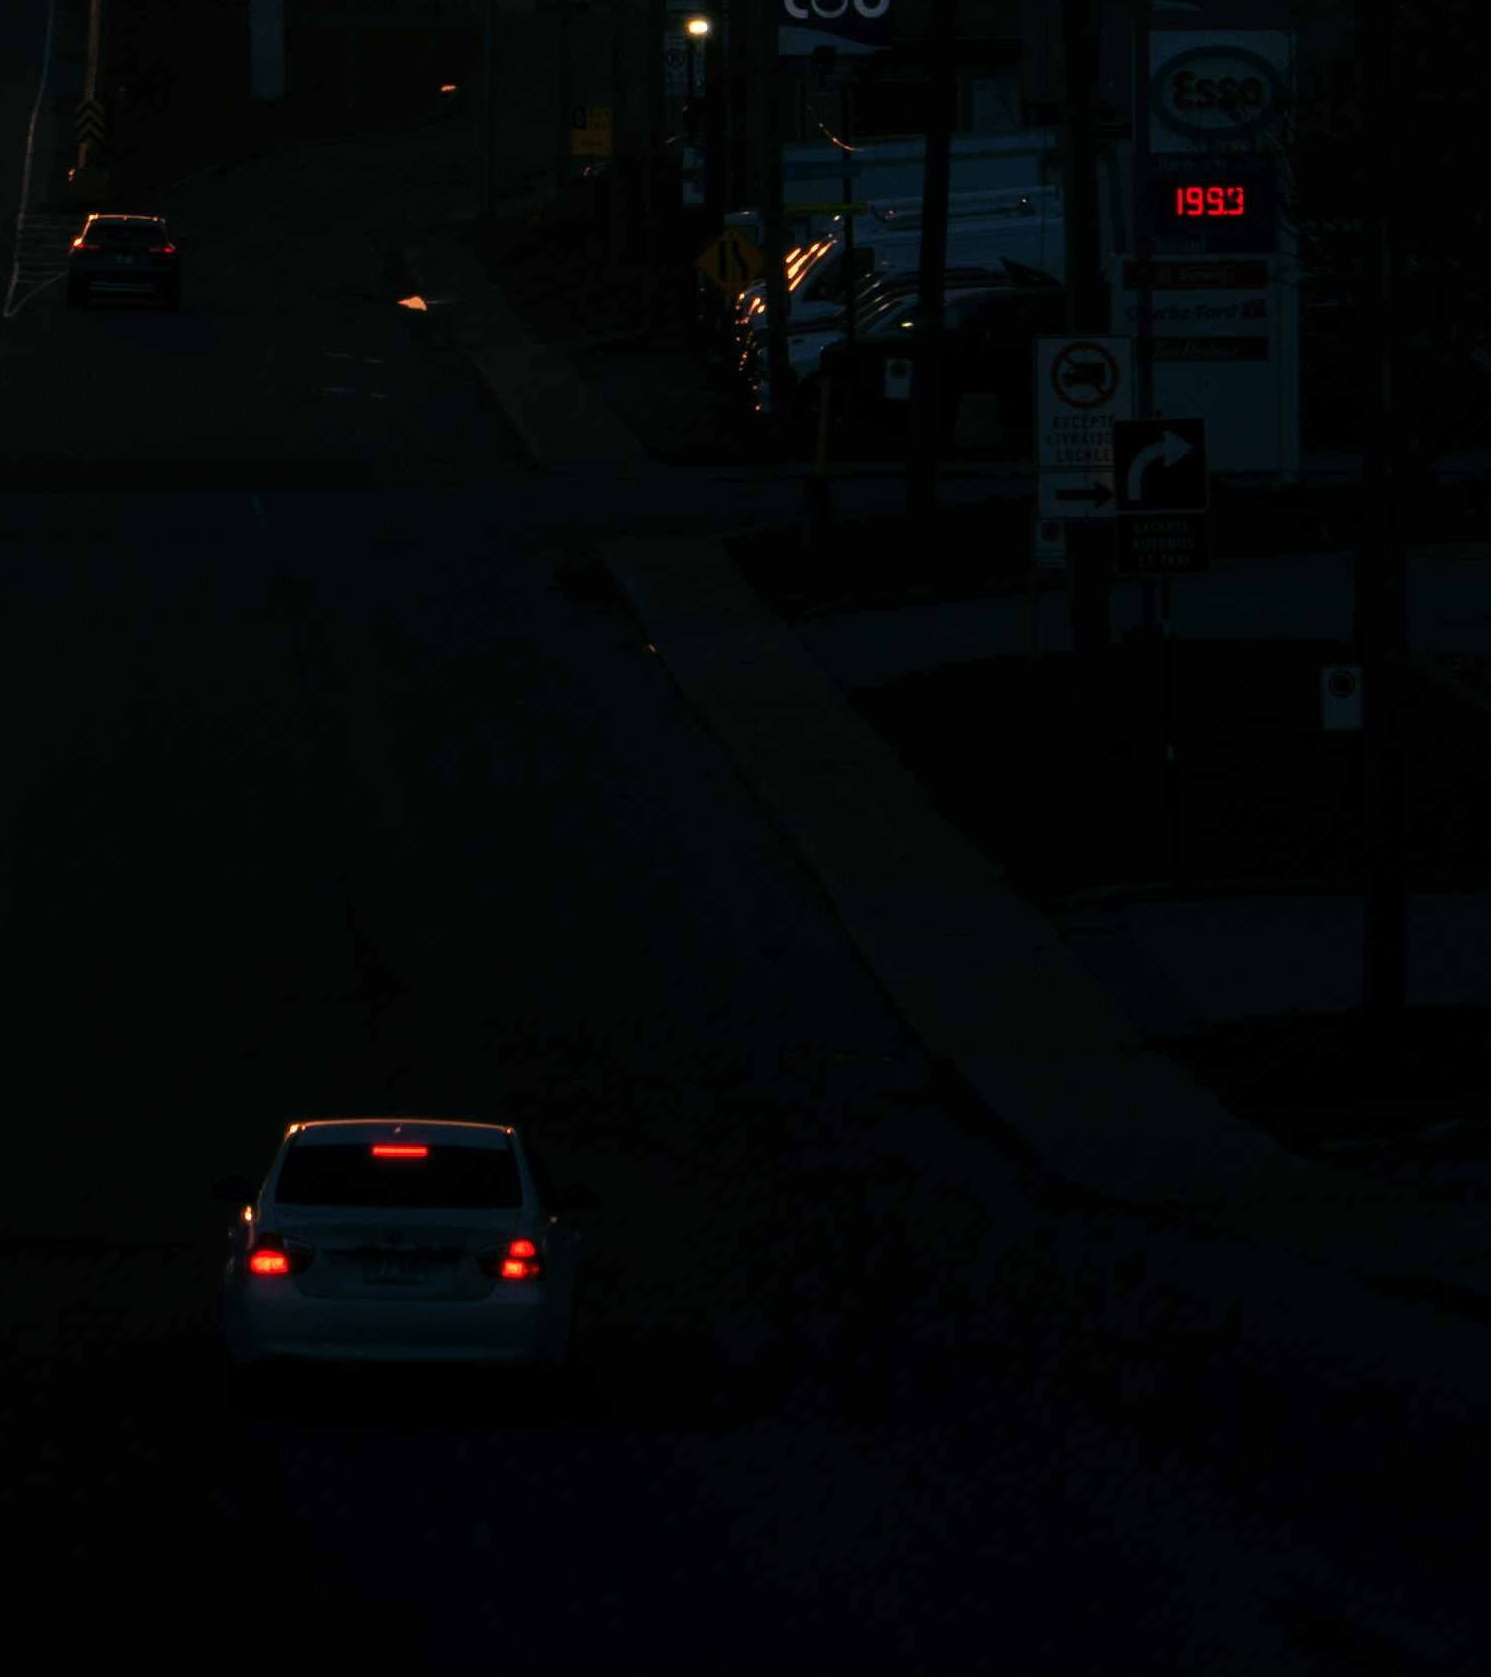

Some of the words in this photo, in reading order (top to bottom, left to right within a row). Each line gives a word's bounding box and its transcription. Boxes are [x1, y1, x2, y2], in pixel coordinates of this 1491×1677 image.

[1173, 70, 1263, 109] Esso
[1178, 267, 1236, 285] Synergy
[1125, 305, 1237, 320] Cuche-Tard
[1152, 340, 1179, 359] Tim
[1133, 518, 1191, 533] EXCEPTÉ
[1132, 537, 1195, 550] AUTOBUS
[1138, 554, 1154, 568] ET
[1160, 553, 1190, 567] TAXI
